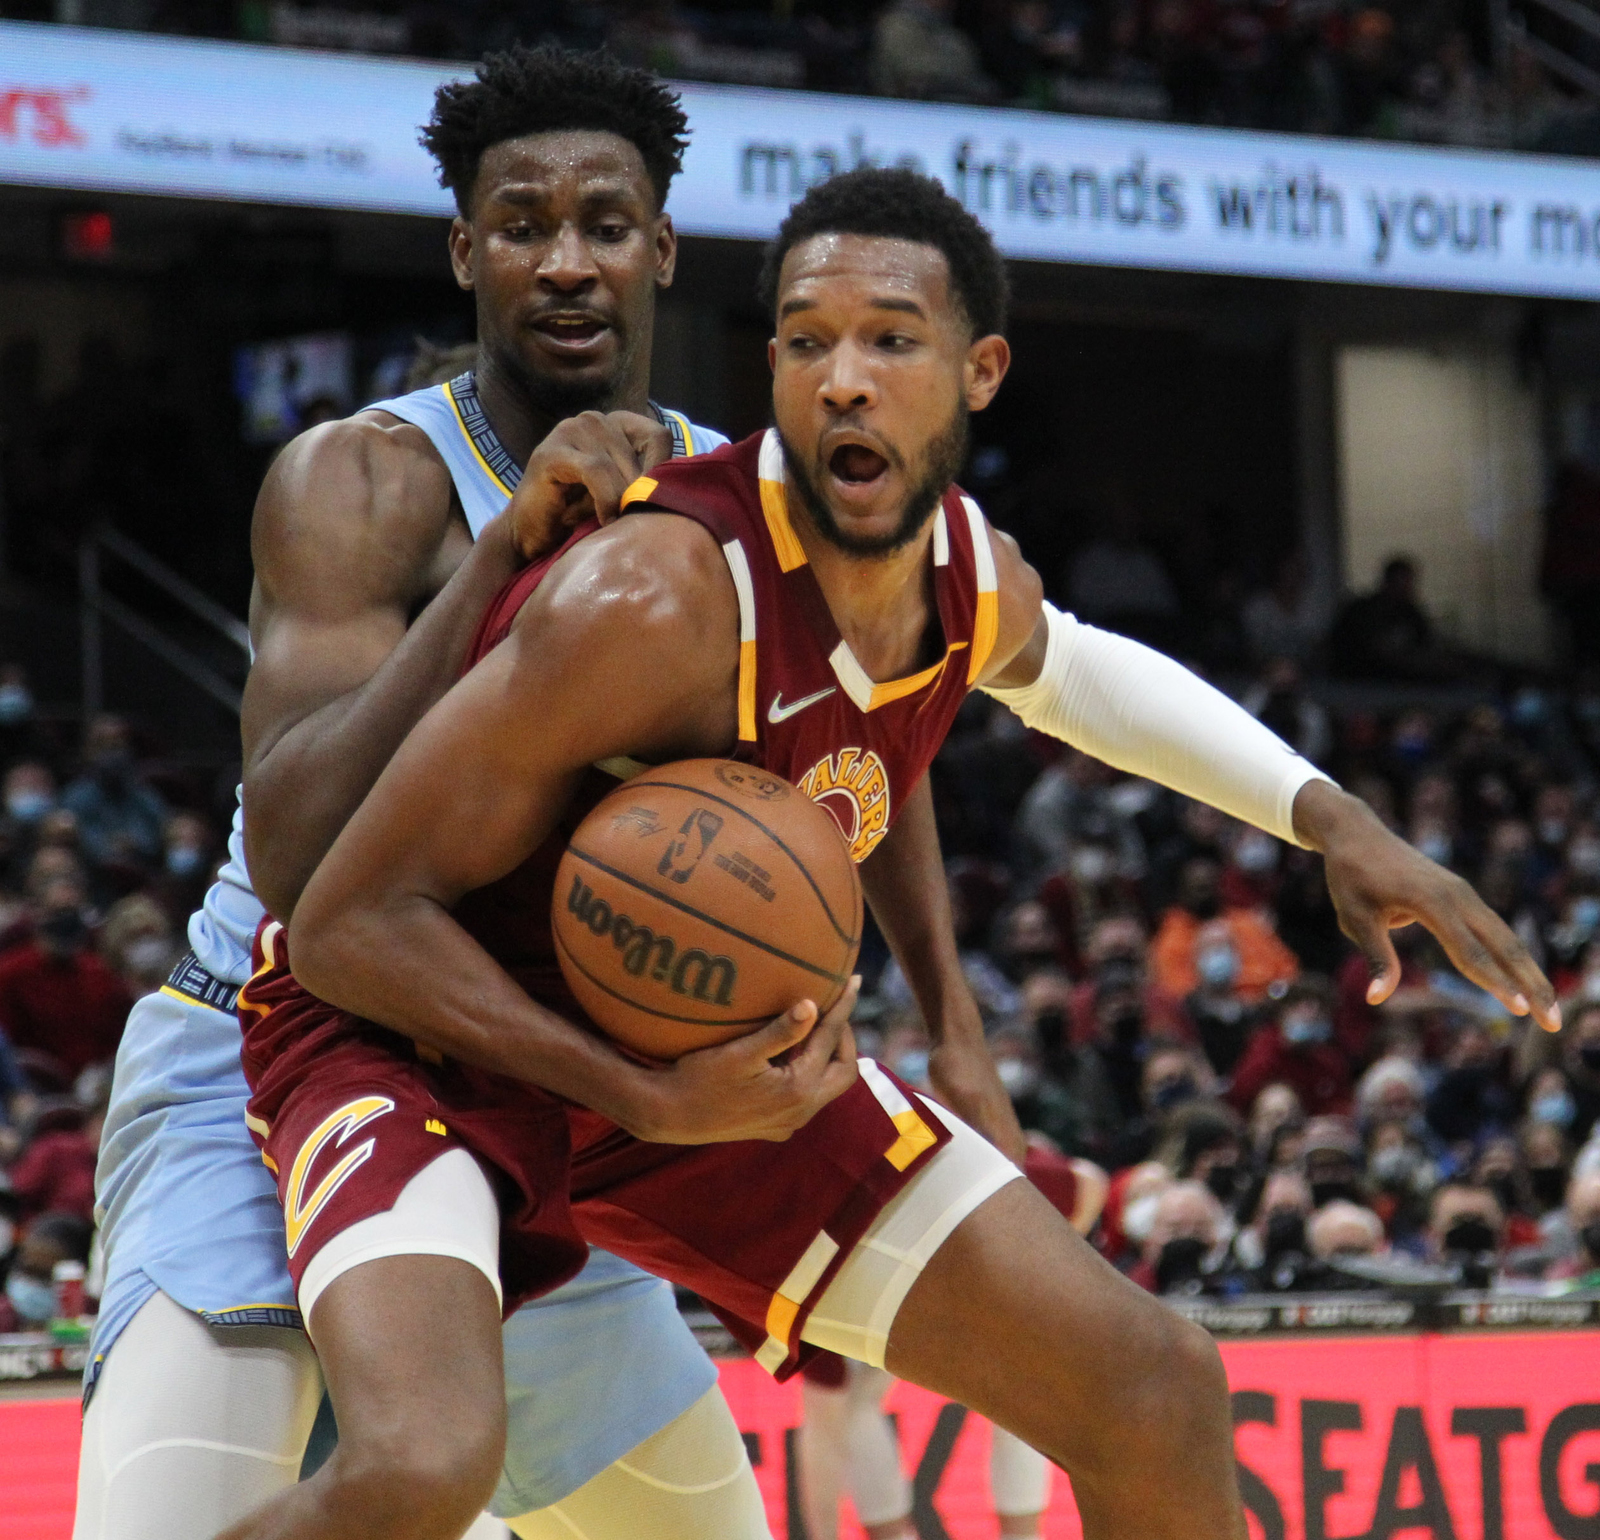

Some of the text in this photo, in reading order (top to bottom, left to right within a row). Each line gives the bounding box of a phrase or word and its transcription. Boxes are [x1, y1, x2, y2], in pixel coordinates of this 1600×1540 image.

[954, 137, 1187, 229] friends
[1209, 160, 1345, 238] with
[1367, 188, 1509, 265] your
[567, 873, 738, 1007] Wilson
